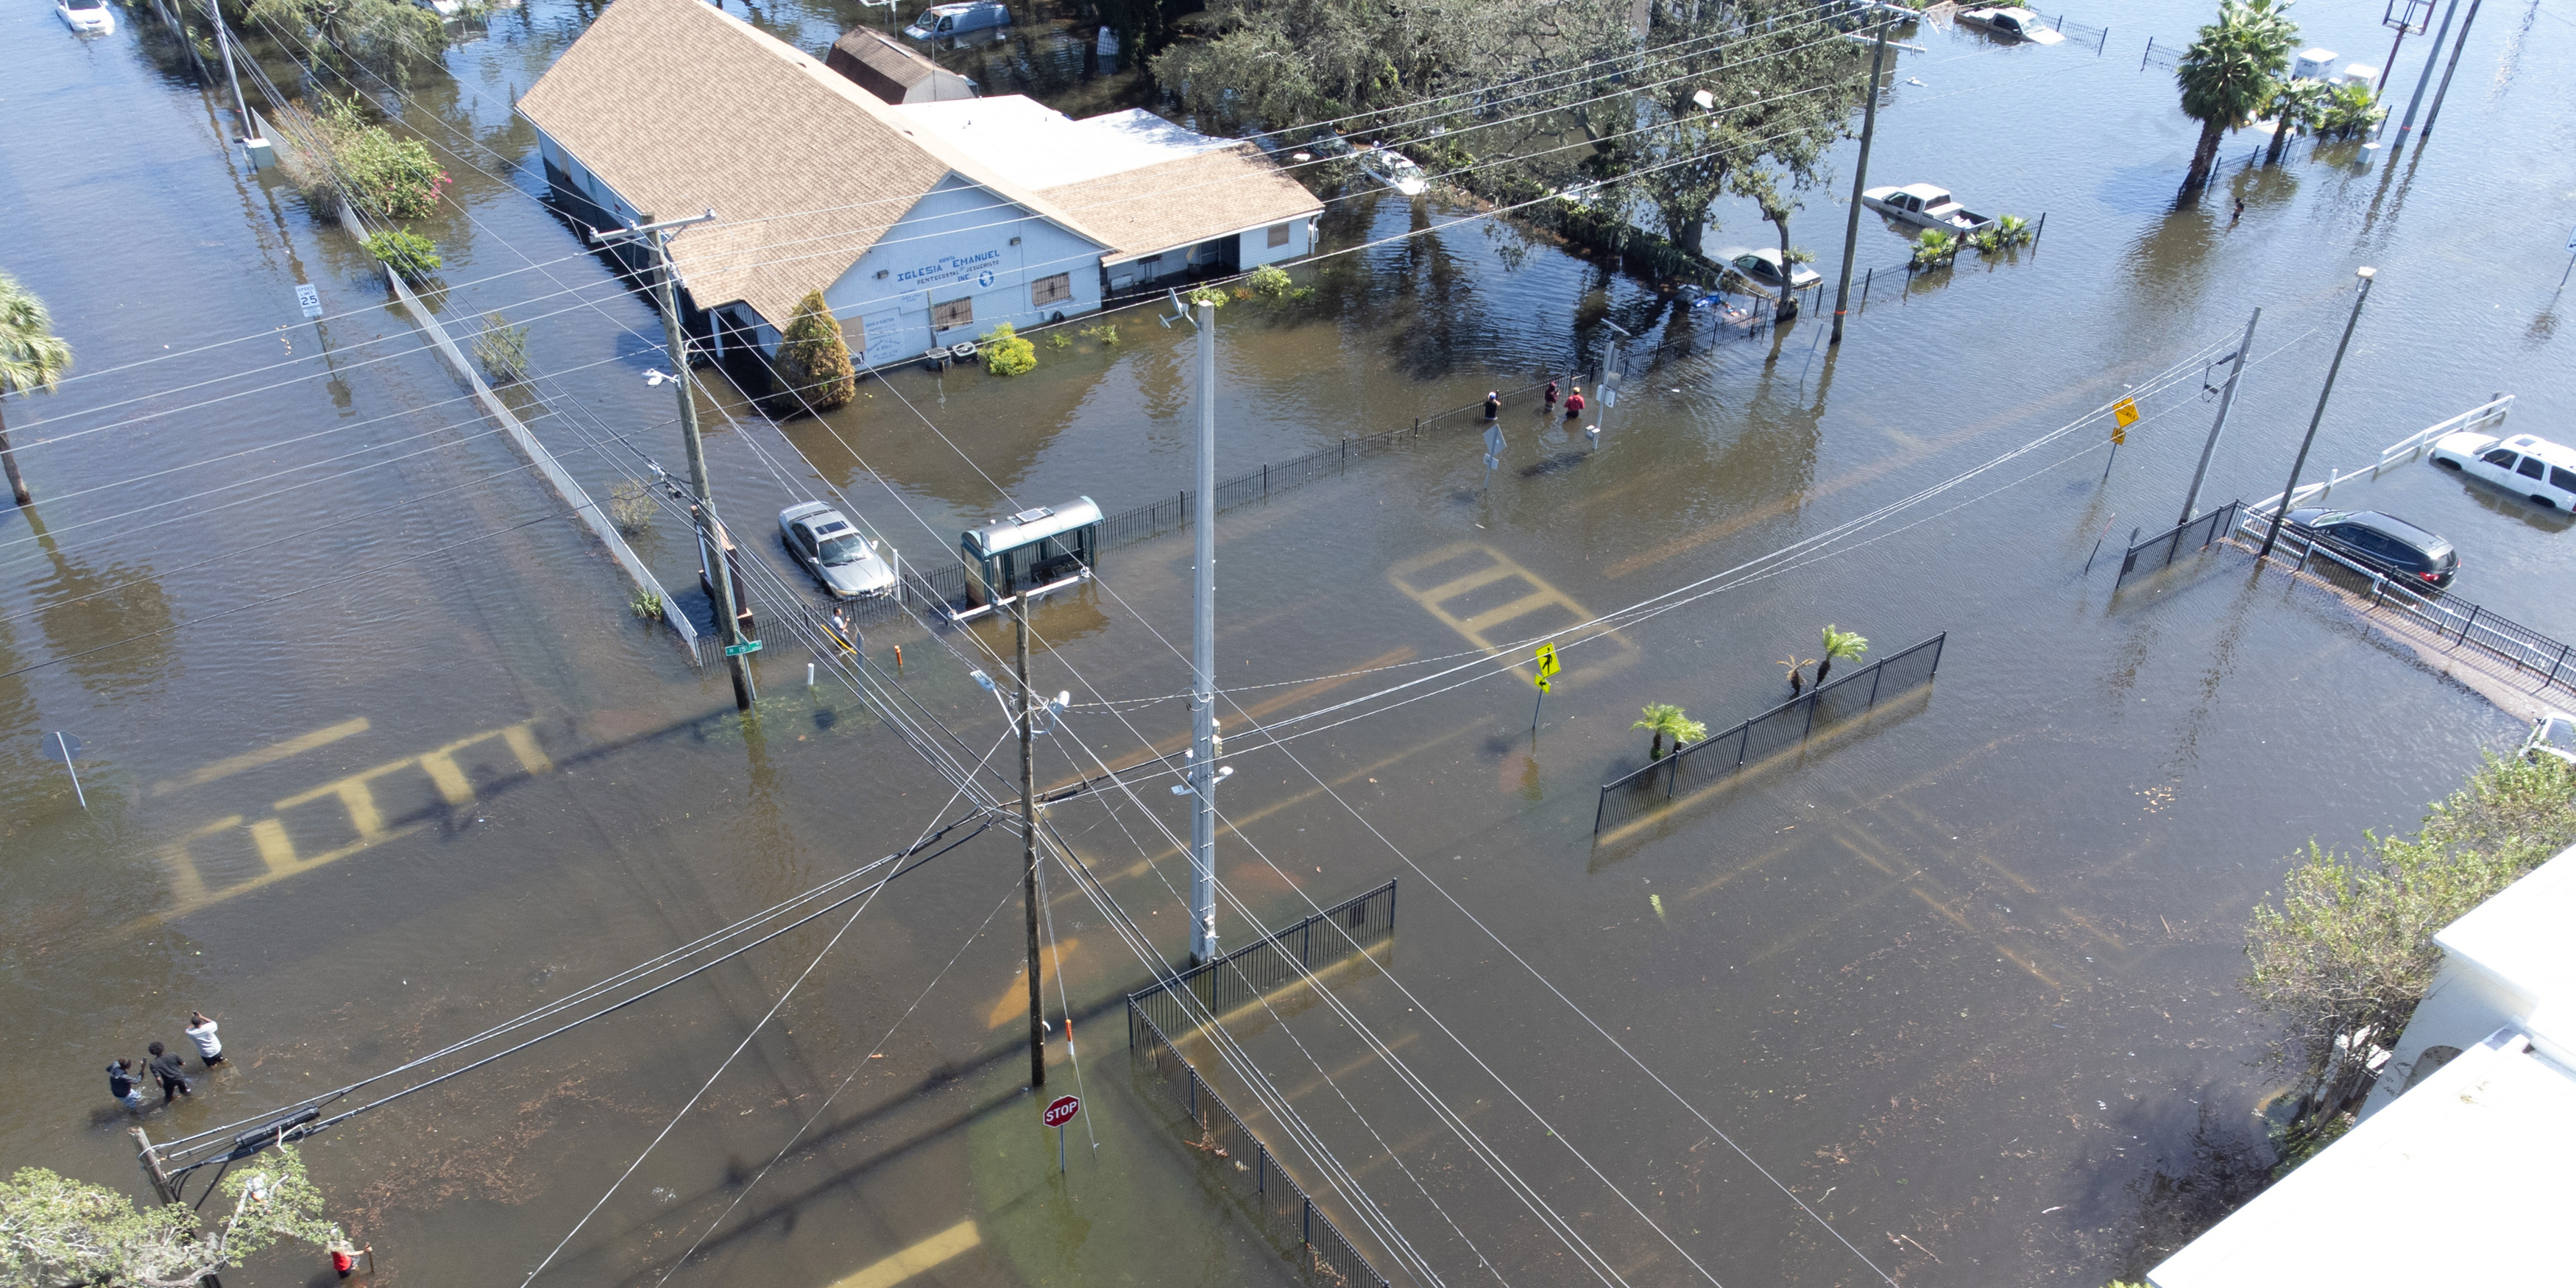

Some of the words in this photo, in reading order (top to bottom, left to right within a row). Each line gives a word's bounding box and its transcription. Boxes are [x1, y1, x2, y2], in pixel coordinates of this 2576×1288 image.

[897, 264, 943, 282] IGLESIA
[952, 250, 1000, 268] EMANUEL
[916, 270, 959, 286] PENTECOSTAL
[966, 260, 999, 272] JESUCRISTO
[300, 295, 317, 305] 25
[1046, 1101, 1078, 1122] STOP
